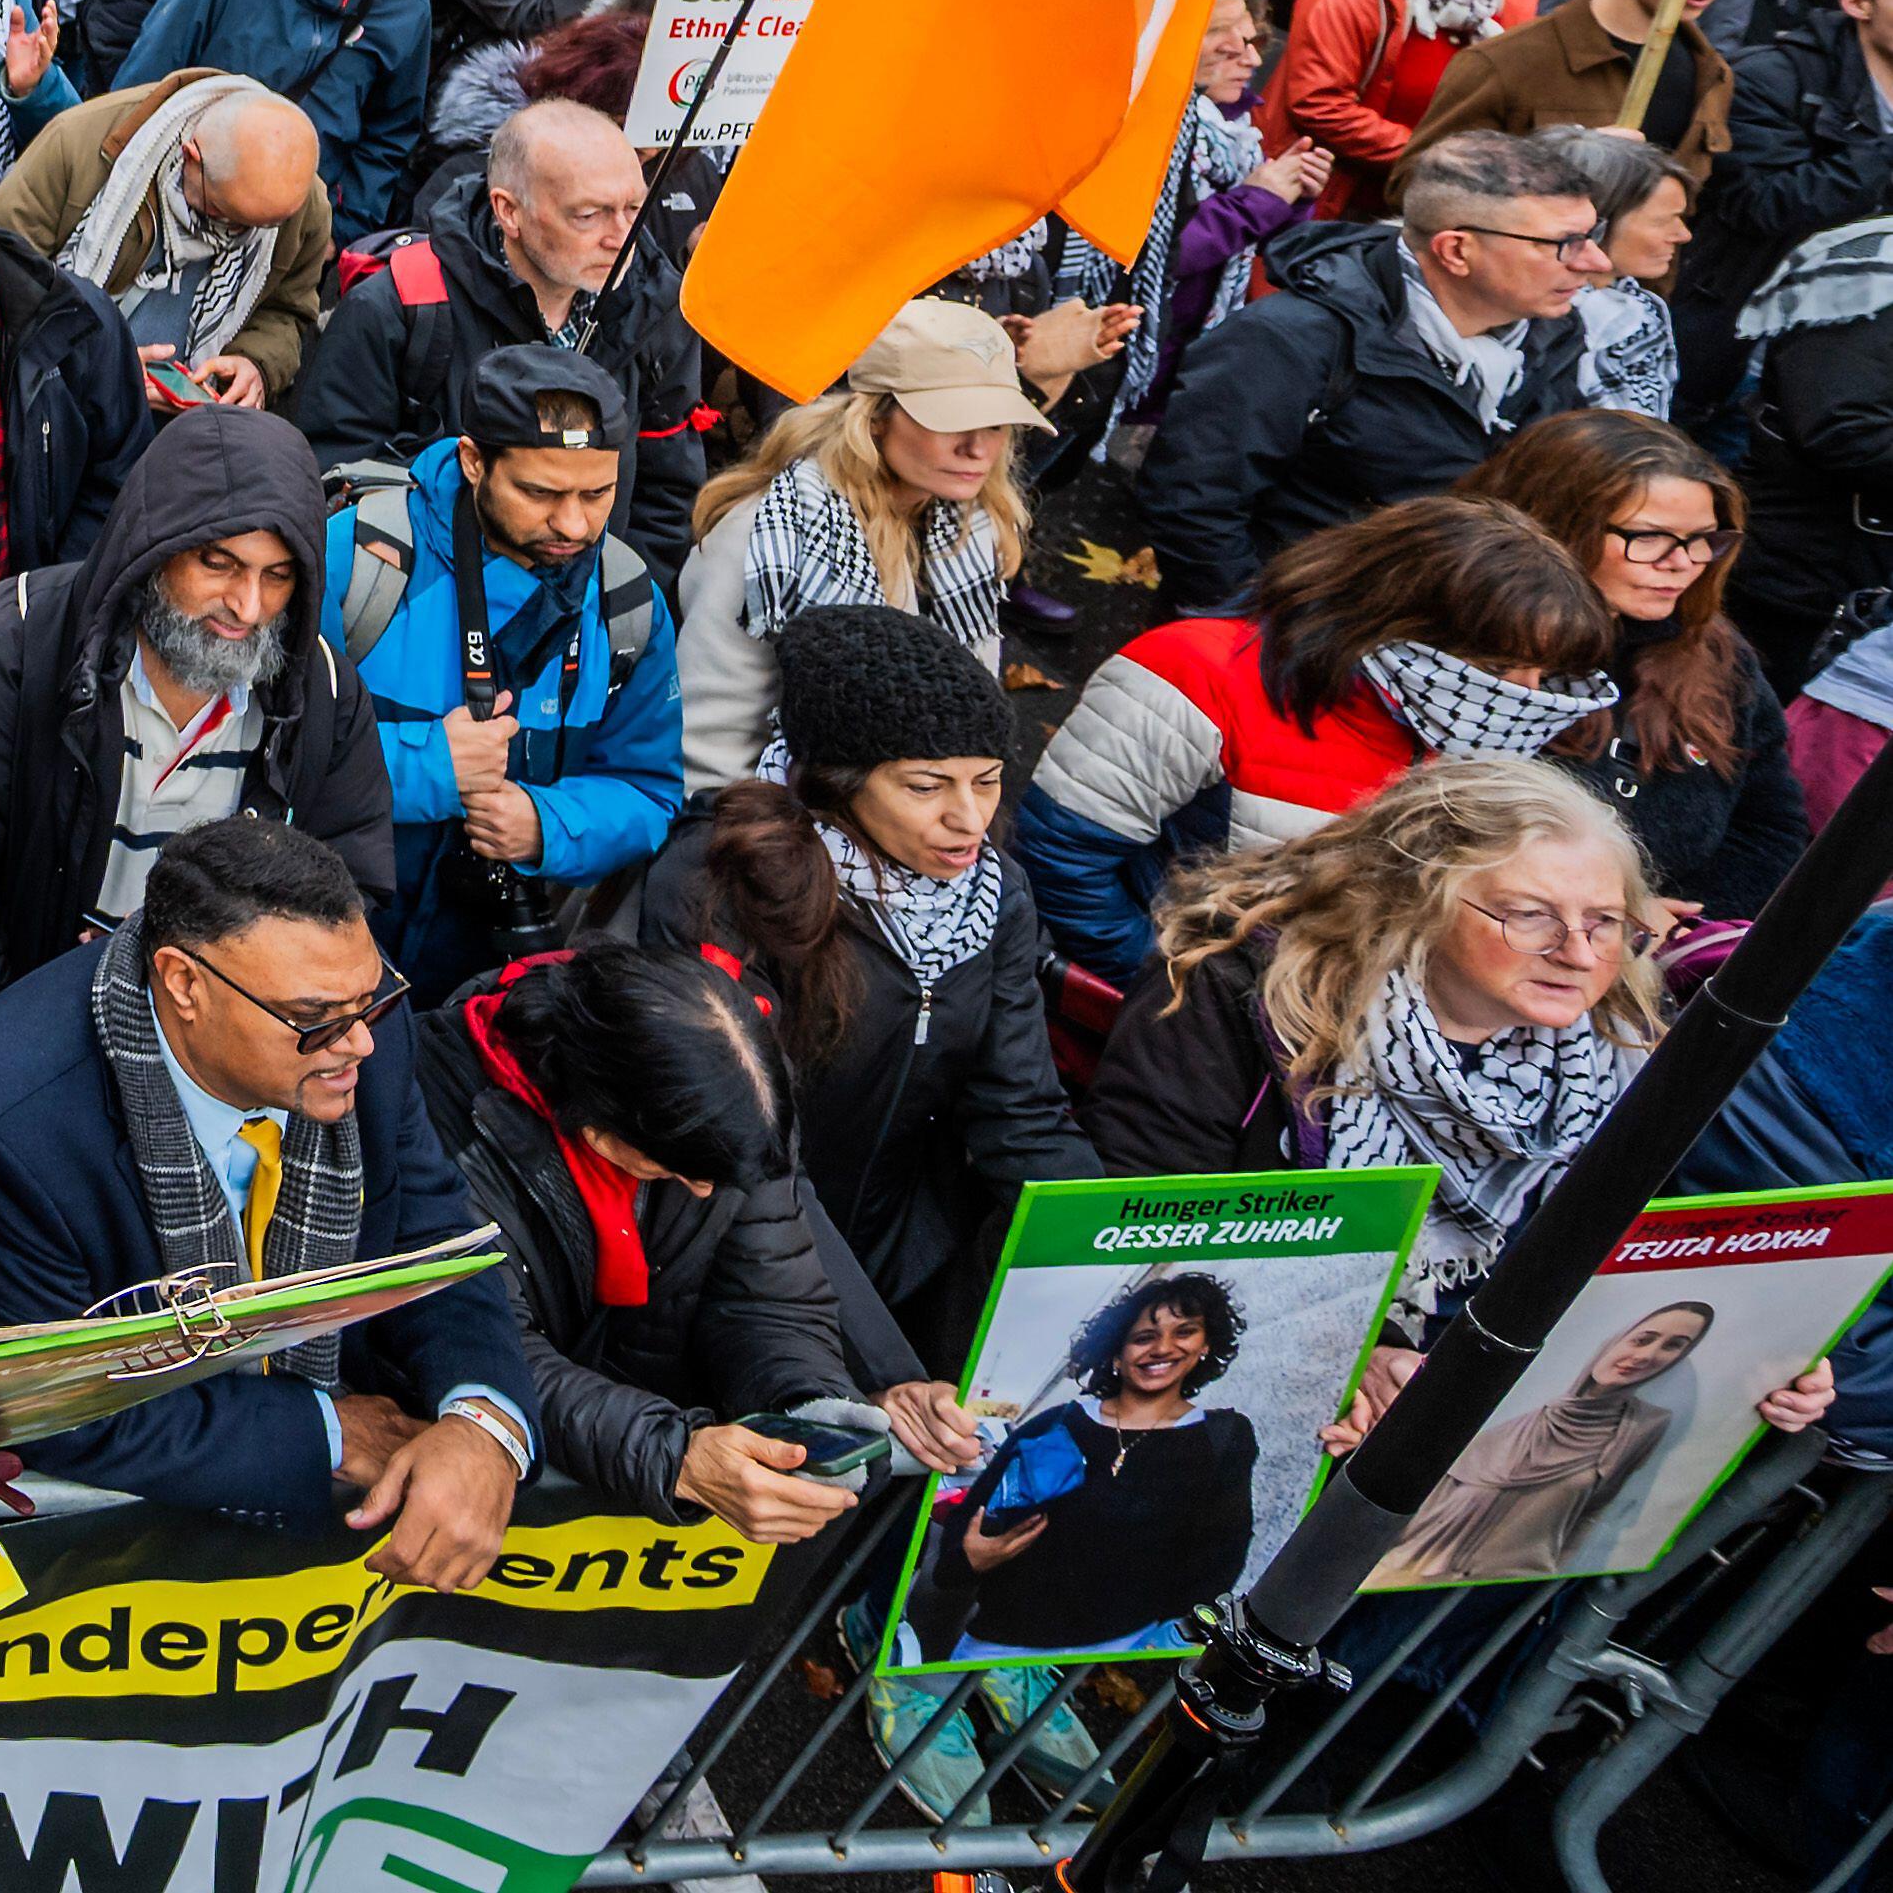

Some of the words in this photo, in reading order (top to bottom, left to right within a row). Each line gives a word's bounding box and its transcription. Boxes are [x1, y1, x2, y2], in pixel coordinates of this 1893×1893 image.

[669, 17, 750, 39] Ethnc
[1120, 1193, 1229, 1223] Hunger
[1235, 1187, 1335, 1216] Striker
[1635, 1213, 1746, 1239] Hunger
[1752, 1205, 1849, 1233] Striker
[1092, 1221, 1208, 1253] QESSER
[1211, 1214, 1342, 1247] ZUHRAH
[1615, 1234, 1712, 1264] TEUTA
[1716, 1225, 1832, 1258] HOXHA
